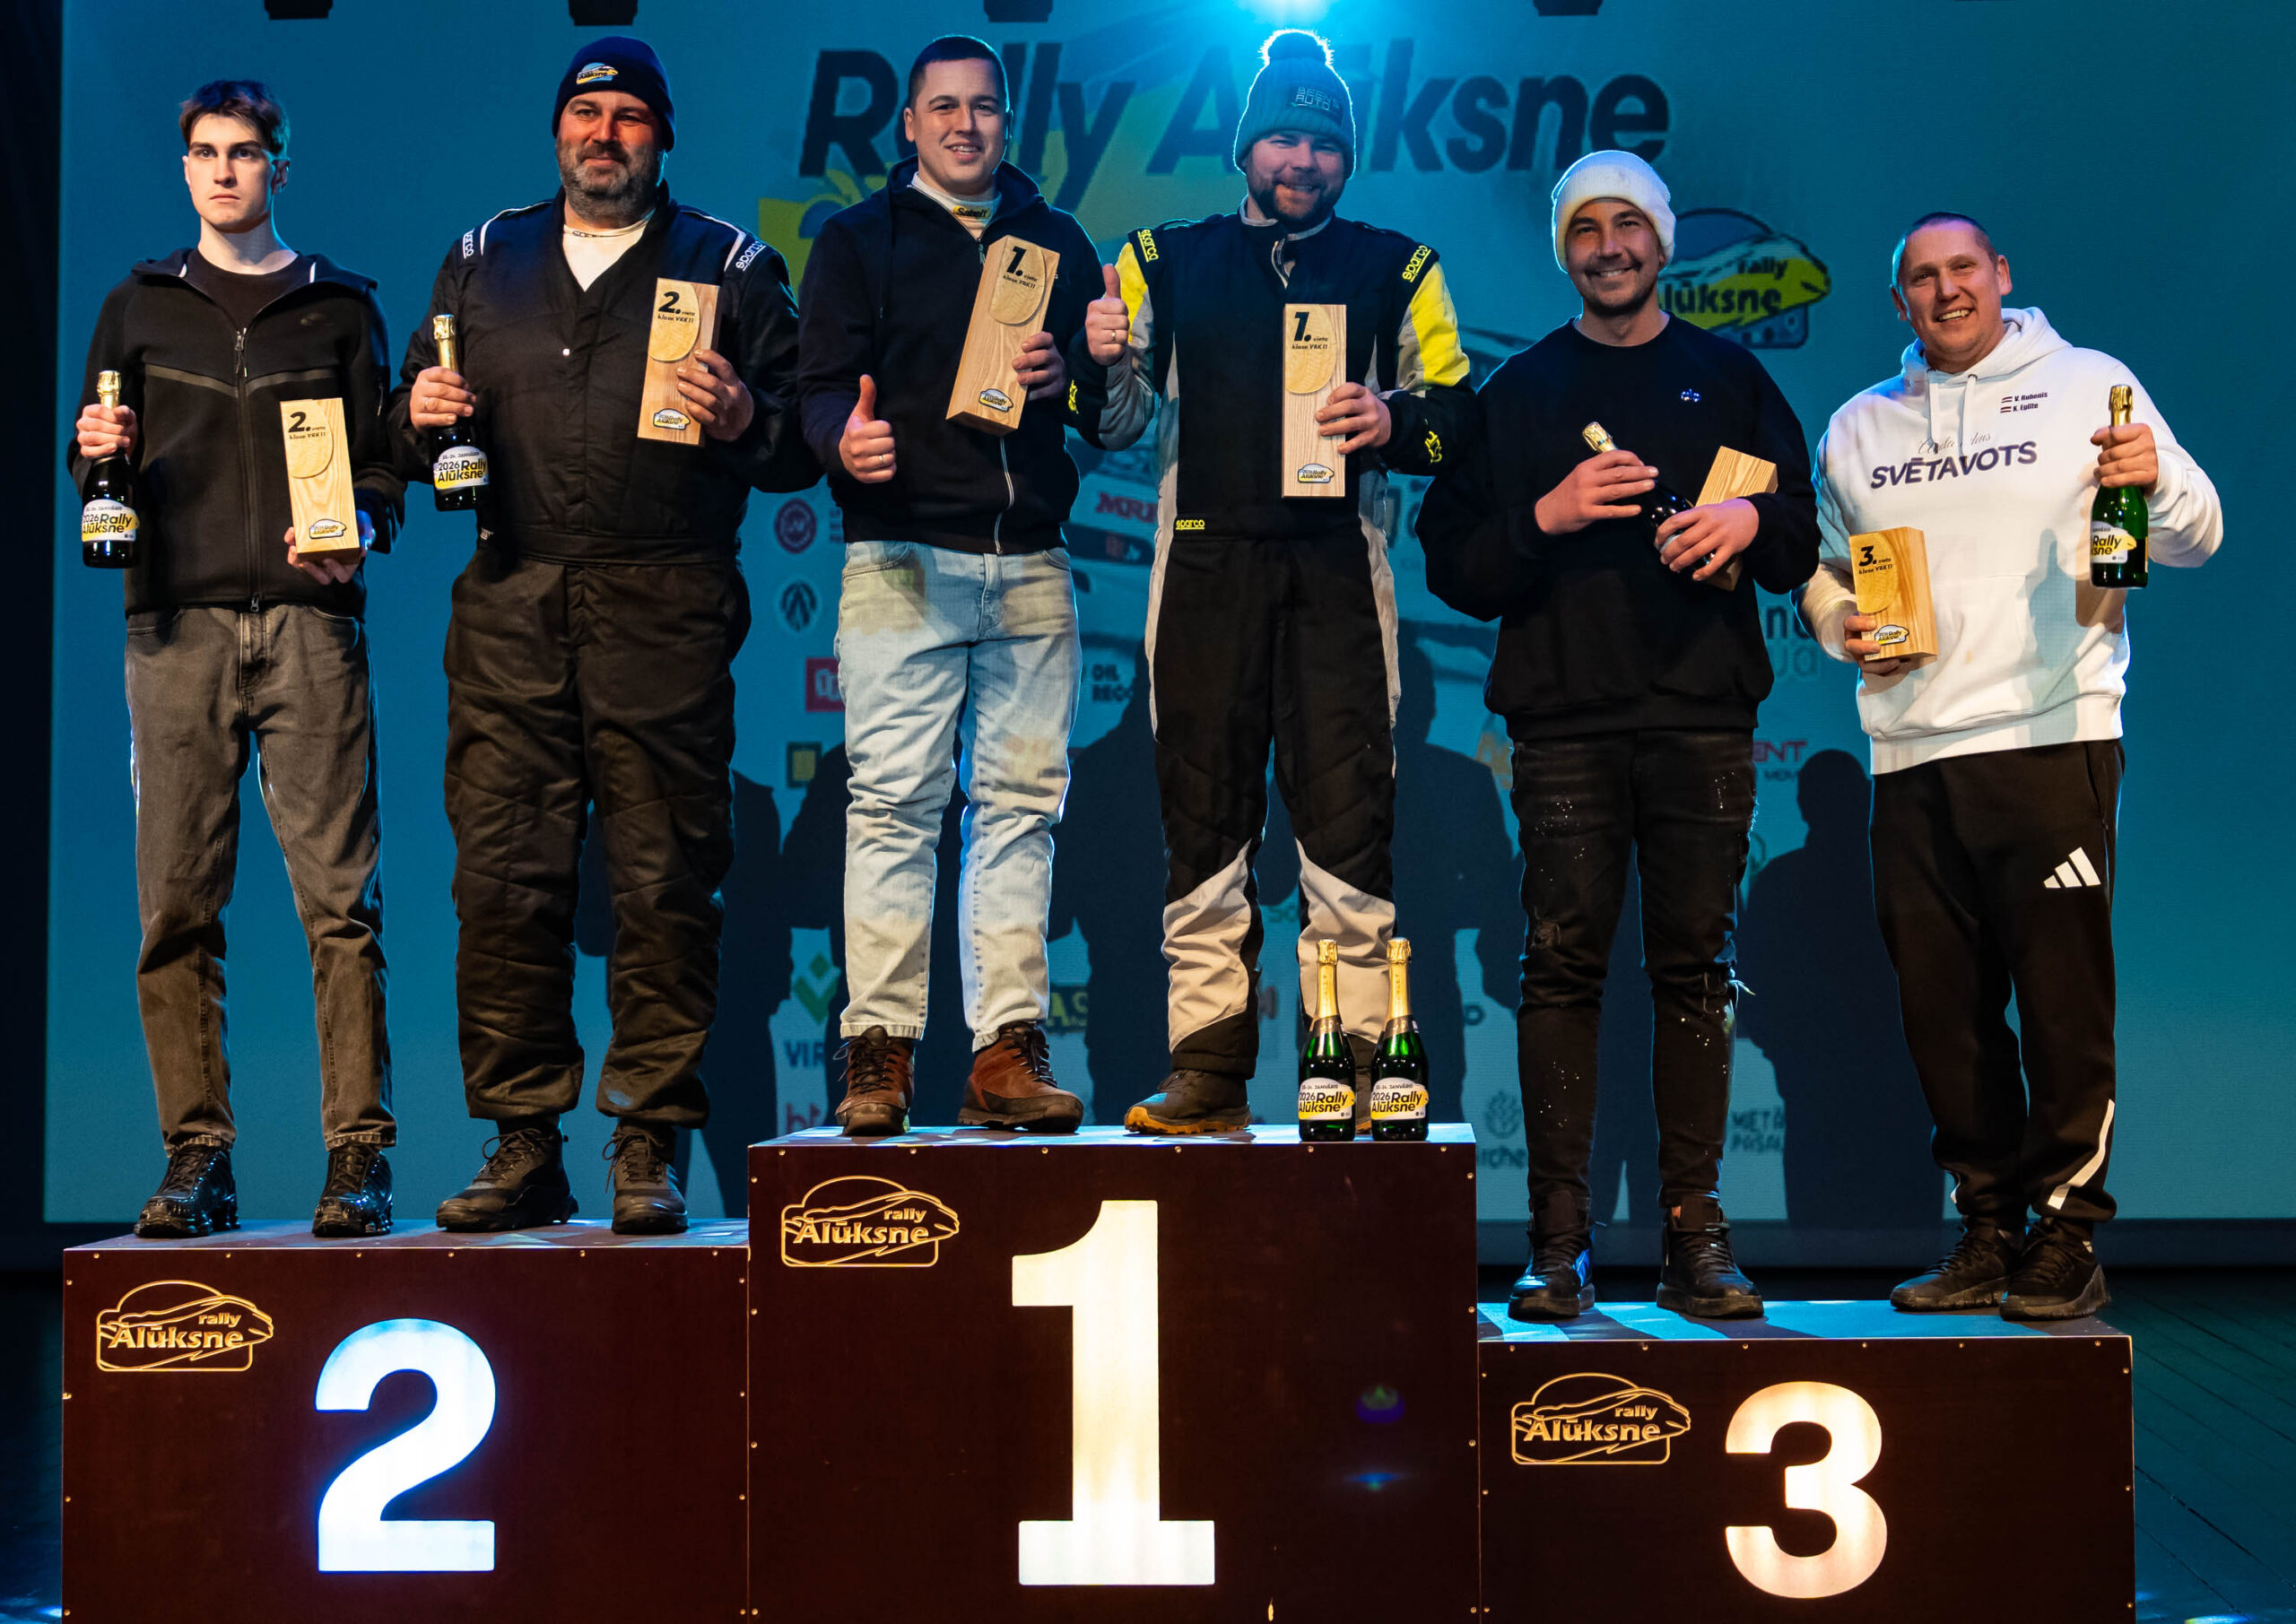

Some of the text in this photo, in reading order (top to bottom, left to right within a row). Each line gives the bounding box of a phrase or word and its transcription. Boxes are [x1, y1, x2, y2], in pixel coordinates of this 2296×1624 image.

[798, 38, 1670, 210] Rlly Aksne
[1006, 246, 1027, 276] 1.
[1737, 256, 1788, 281] rally
[658, 291, 681, 314] 2.
[1659, 280, 1782, 315] lūksne
[1294, 311, 1312, 342] 1.
[288, 411, 310, 433] 2.
[438, 468, 483, 482] Alūksne
[439, 460, 460, 472] 2026
[1870, 440, 2038, 490] SVĒTAVOTS
[100, 513, 133, 528] Rally
[1175, 519, 1205, 531] sparco
[2092, 534, 2122, 549] Rally
[1858, 544, 1877, 567] 3.
[1299, 1101, 1341, 1113] Alūksne
[1300, 1090, 1348, 1106] 2026 Rally
[1372, 1090, 1422, 1106] 2026 Rally
[1372, 1101, 1416, 1113] Alūksne
[883, 1208, 927, 1223] rally
[793, 1220, 929, 1245] Alūksne
[197, 1312, 242, 1328] rally
[107, 1324, 244, 1349] Alūksne
[1012, 1200, 1215, 1585] 1
[1614, 1404, 1659, 1420] rally
[1523, 1418, 1661, 1442] Alūksne
[315, 1318, 497, 1574] 2
[1725, 1381, 1888, 1598] 3
